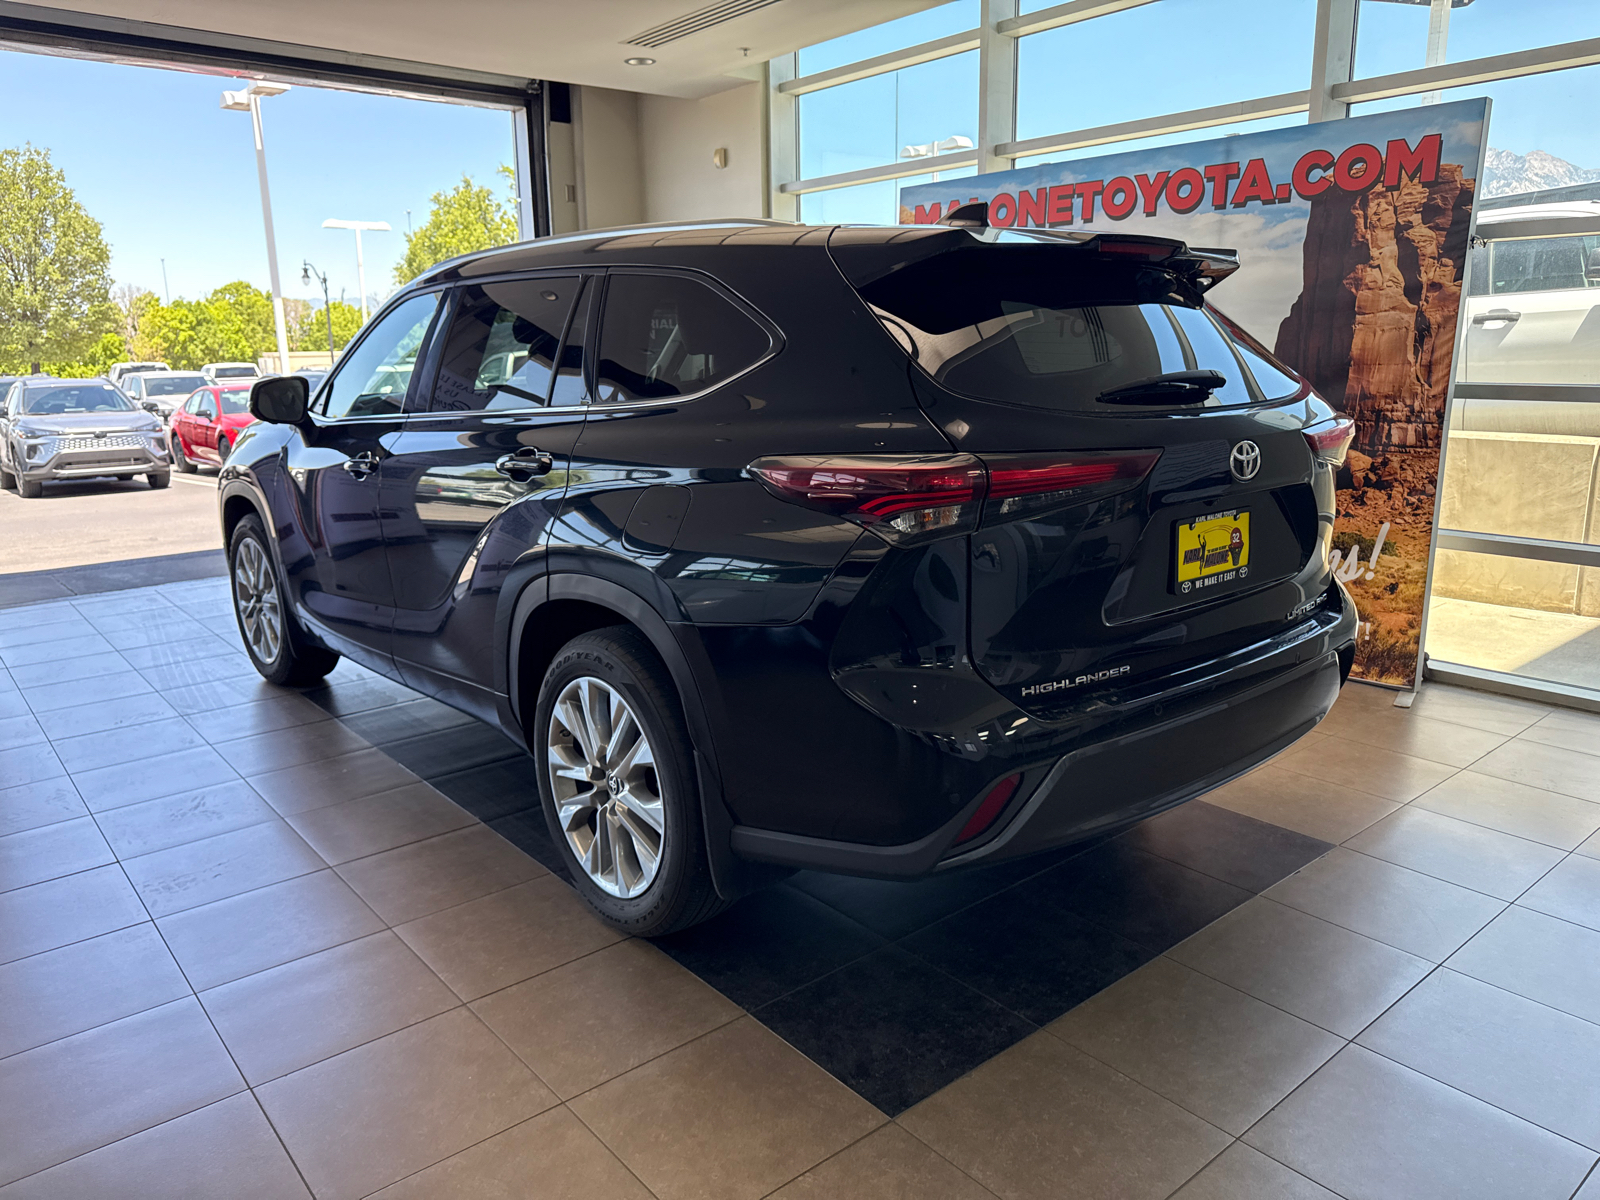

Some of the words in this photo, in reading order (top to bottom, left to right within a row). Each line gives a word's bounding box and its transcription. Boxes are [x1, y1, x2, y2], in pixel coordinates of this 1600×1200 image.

[914, 133, 1444, 228] MONETOYOTA.COM
[1232, 532, 1240, 543] 32
[1195, 580, 1203, 589] WE
[1204, 575, 1217, 587] MAKE
[1218, 574, 1224, 583] IT
[1224, 570, 1236, 581] EASY
[1287, 601, 1315, 620] LIMITED
[544, 651, 615, 689] GOODYEAR
[1021, 665, 1131, 697] HIGHLANDER
